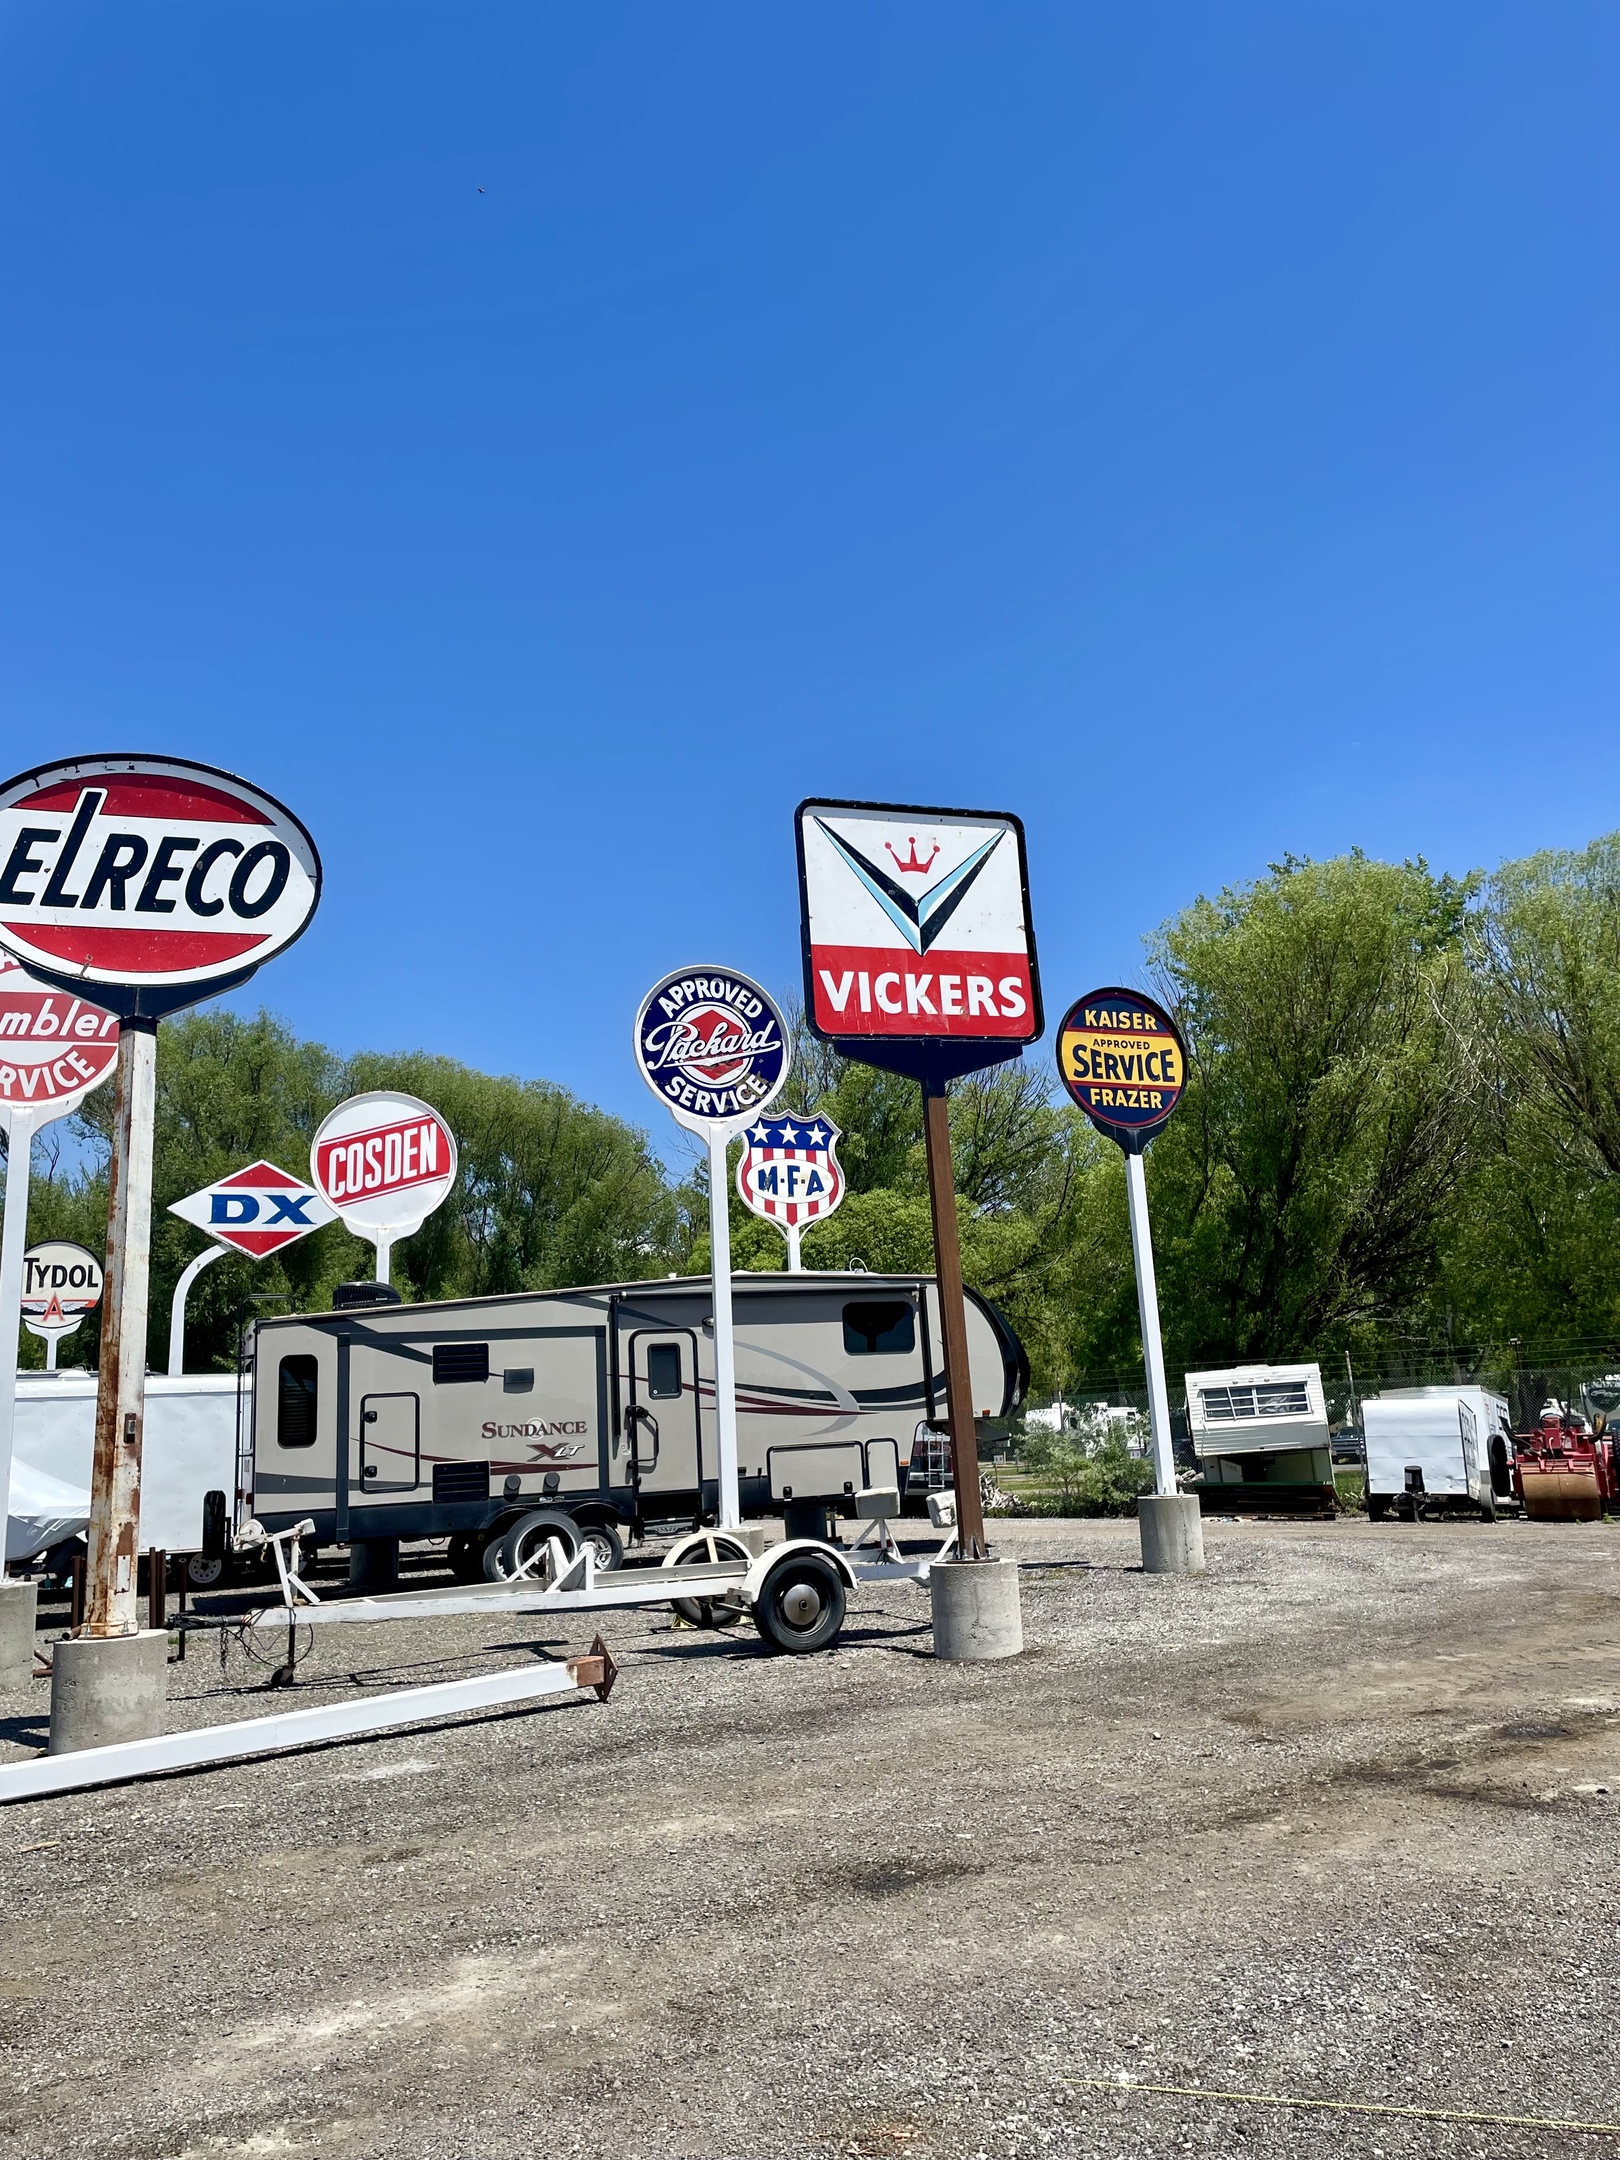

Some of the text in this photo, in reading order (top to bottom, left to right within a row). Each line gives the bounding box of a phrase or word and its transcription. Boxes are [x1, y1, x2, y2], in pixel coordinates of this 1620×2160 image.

[0, 791, 290, 919] ELRECO
[658, 977, 763, 1018] APPROVED
[818, 969, 1026, 1018] VICKERS
[1085, 1009, 1157, 1030] KAISER
[645, 1019, 782, 1070] Packard
[1072, 1044, 1176, 1082] SERVICE
[1093, 1038, 1150, 1050] APPROVED
[665, 1075, 768, 1113] SERVICE
[1090, 1088, 1162, 1109] FRAZER
[328, 1122, 437, 1199] COSDEN
[208, 1194, 317, 1225] DX
[23, 1257, 99, 1295] TYDOL
[481, 1421, 588, 1440] SUNDANCE
[526, 1442, 586, 1462] XLT
